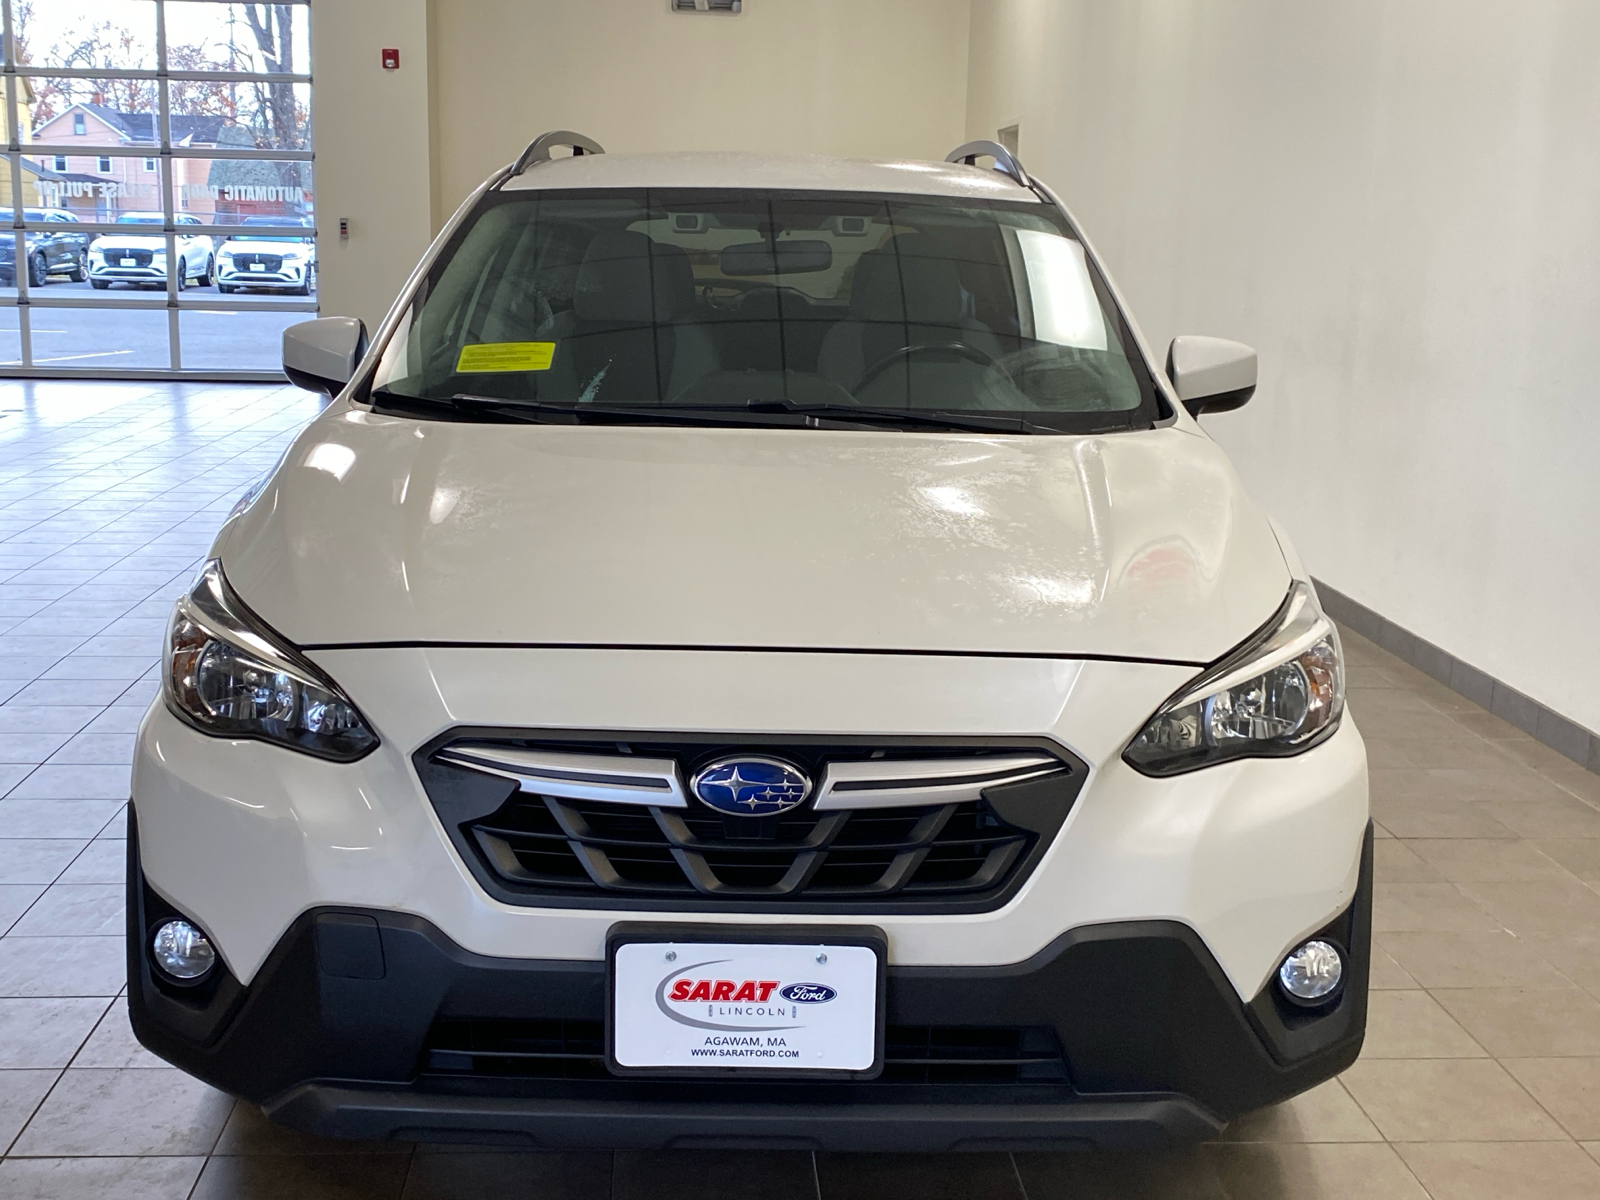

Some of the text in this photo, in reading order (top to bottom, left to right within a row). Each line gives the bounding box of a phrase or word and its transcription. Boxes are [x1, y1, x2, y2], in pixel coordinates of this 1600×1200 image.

[668, 979, 826, 1003] SARAT Ford
[719, 1007, 786, 1016] LINCOLN
[704, 1036, 787, 1047] AGAWAM, MA
[691, 1048, 800, 1058] WWW.SARATFORD.COM
